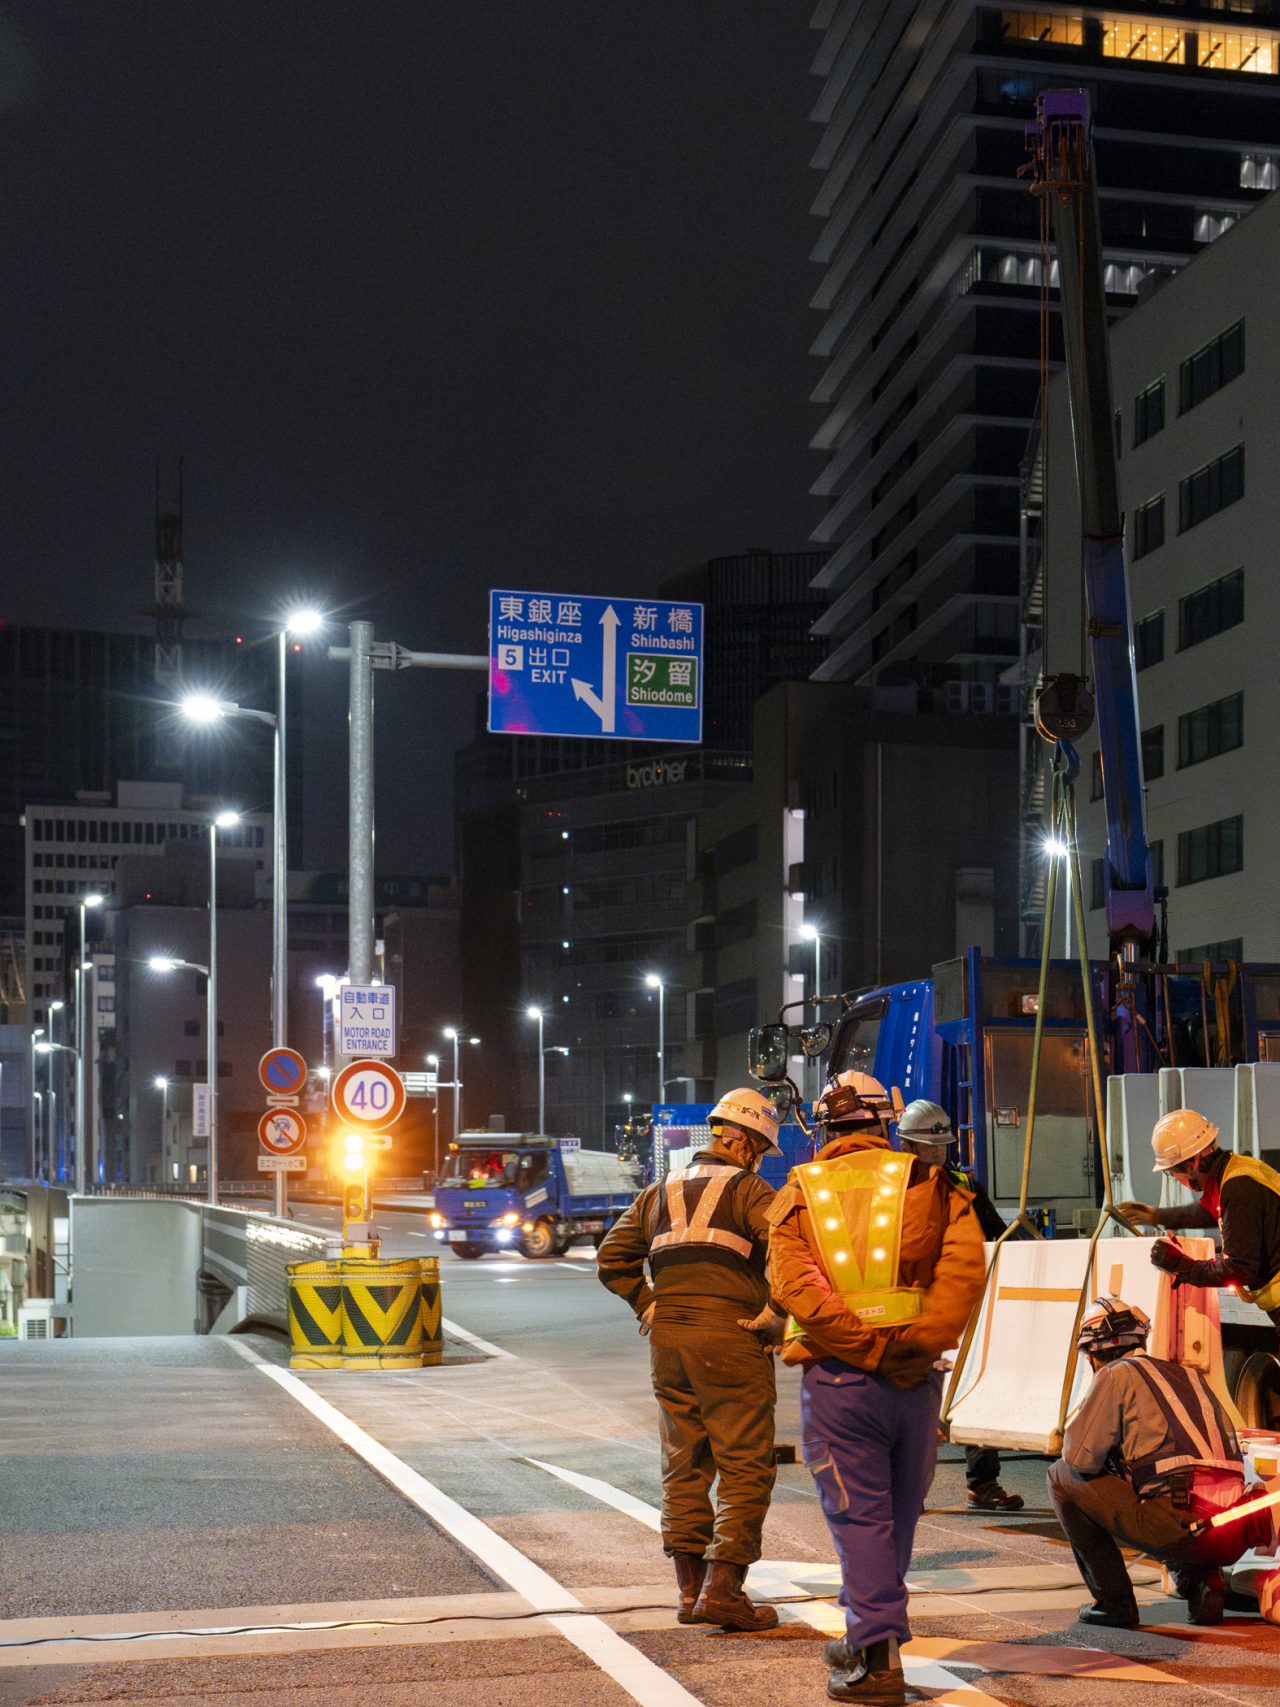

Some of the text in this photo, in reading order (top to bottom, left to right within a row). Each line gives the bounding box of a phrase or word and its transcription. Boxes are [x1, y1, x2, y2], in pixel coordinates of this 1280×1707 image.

[498, 596, 582, 627] 東銀座
[633, 605, 693, 634] 新橋
[497, 625, 582, 644] Higashiginza
[631, 633, 694, 650] Shinbashi
[504, 647, 570, 667] 5 出口
[531, 669, 566, 684] EXIT
[633, 658, 691, 687] 汐留
[631, 687, 693, 703] Shiodome
[626, 760, 687, 789] brother
[344, 991, 390, 1005] 自動車道
[350, 1007, 385, 1020] 入口
[344, 1027, 390, 1039] MOTOR ROAD
[346, 1039, 388, 1051] ENTRANCE
[350, 1080, 388, 1110] 40
